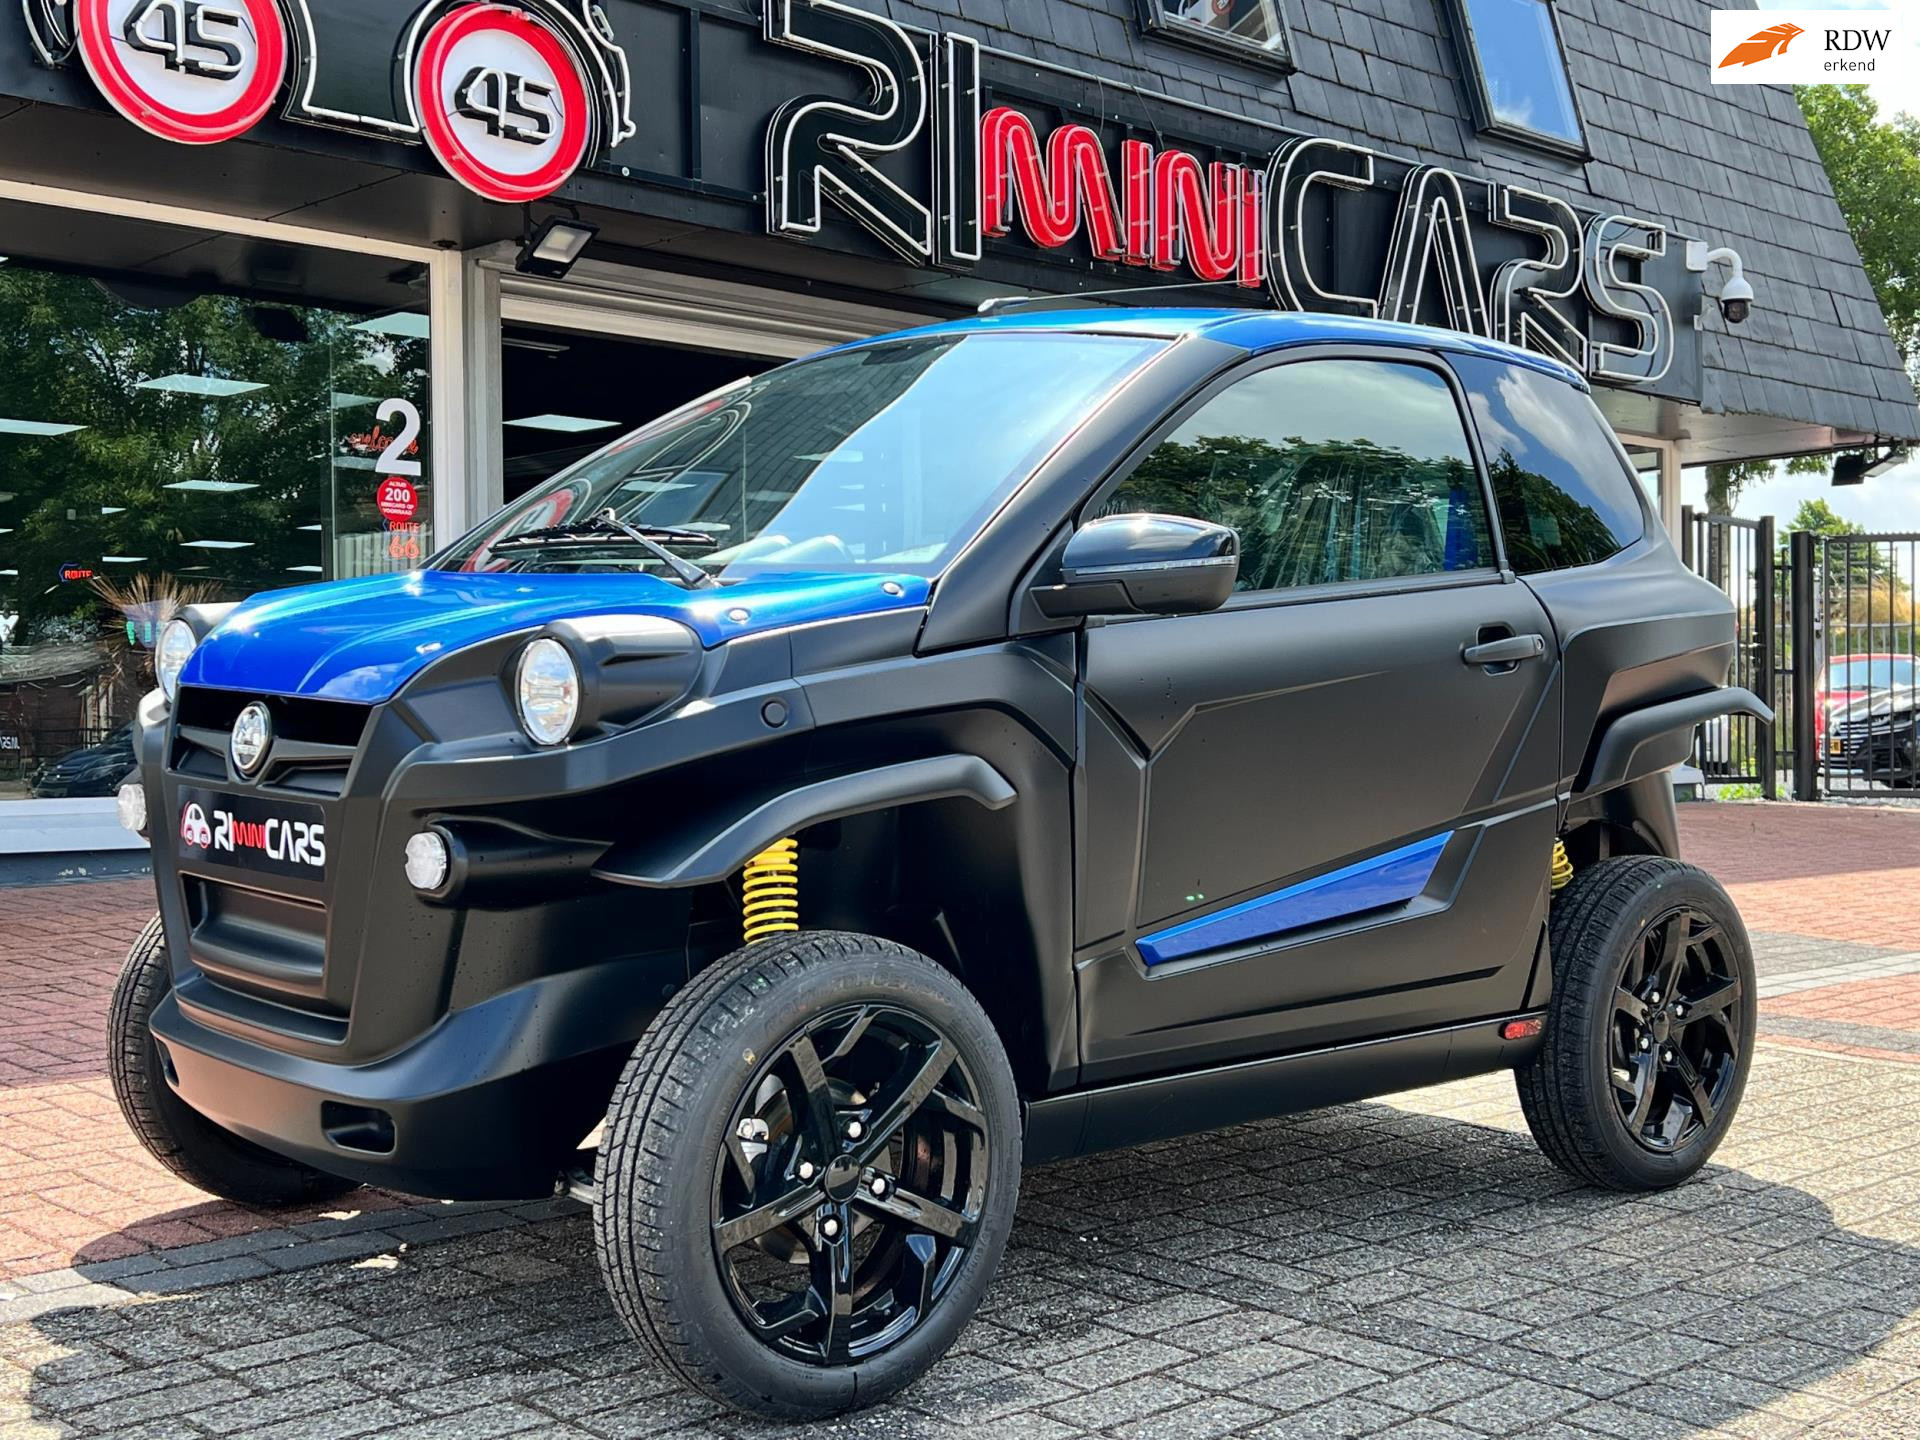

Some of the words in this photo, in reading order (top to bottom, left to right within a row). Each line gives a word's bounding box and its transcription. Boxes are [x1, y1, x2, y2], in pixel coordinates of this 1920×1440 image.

[123, 0, 246, 81] 45
[455, 66, 556, 146] 45
[375, 397, 422, 477] 2
[384, 487, 411, 503] 200
[389, 521, 420, 534] ROUTE
[389, 534, 420, 559] 66
[64, 569, 93, 580] ROUTE
